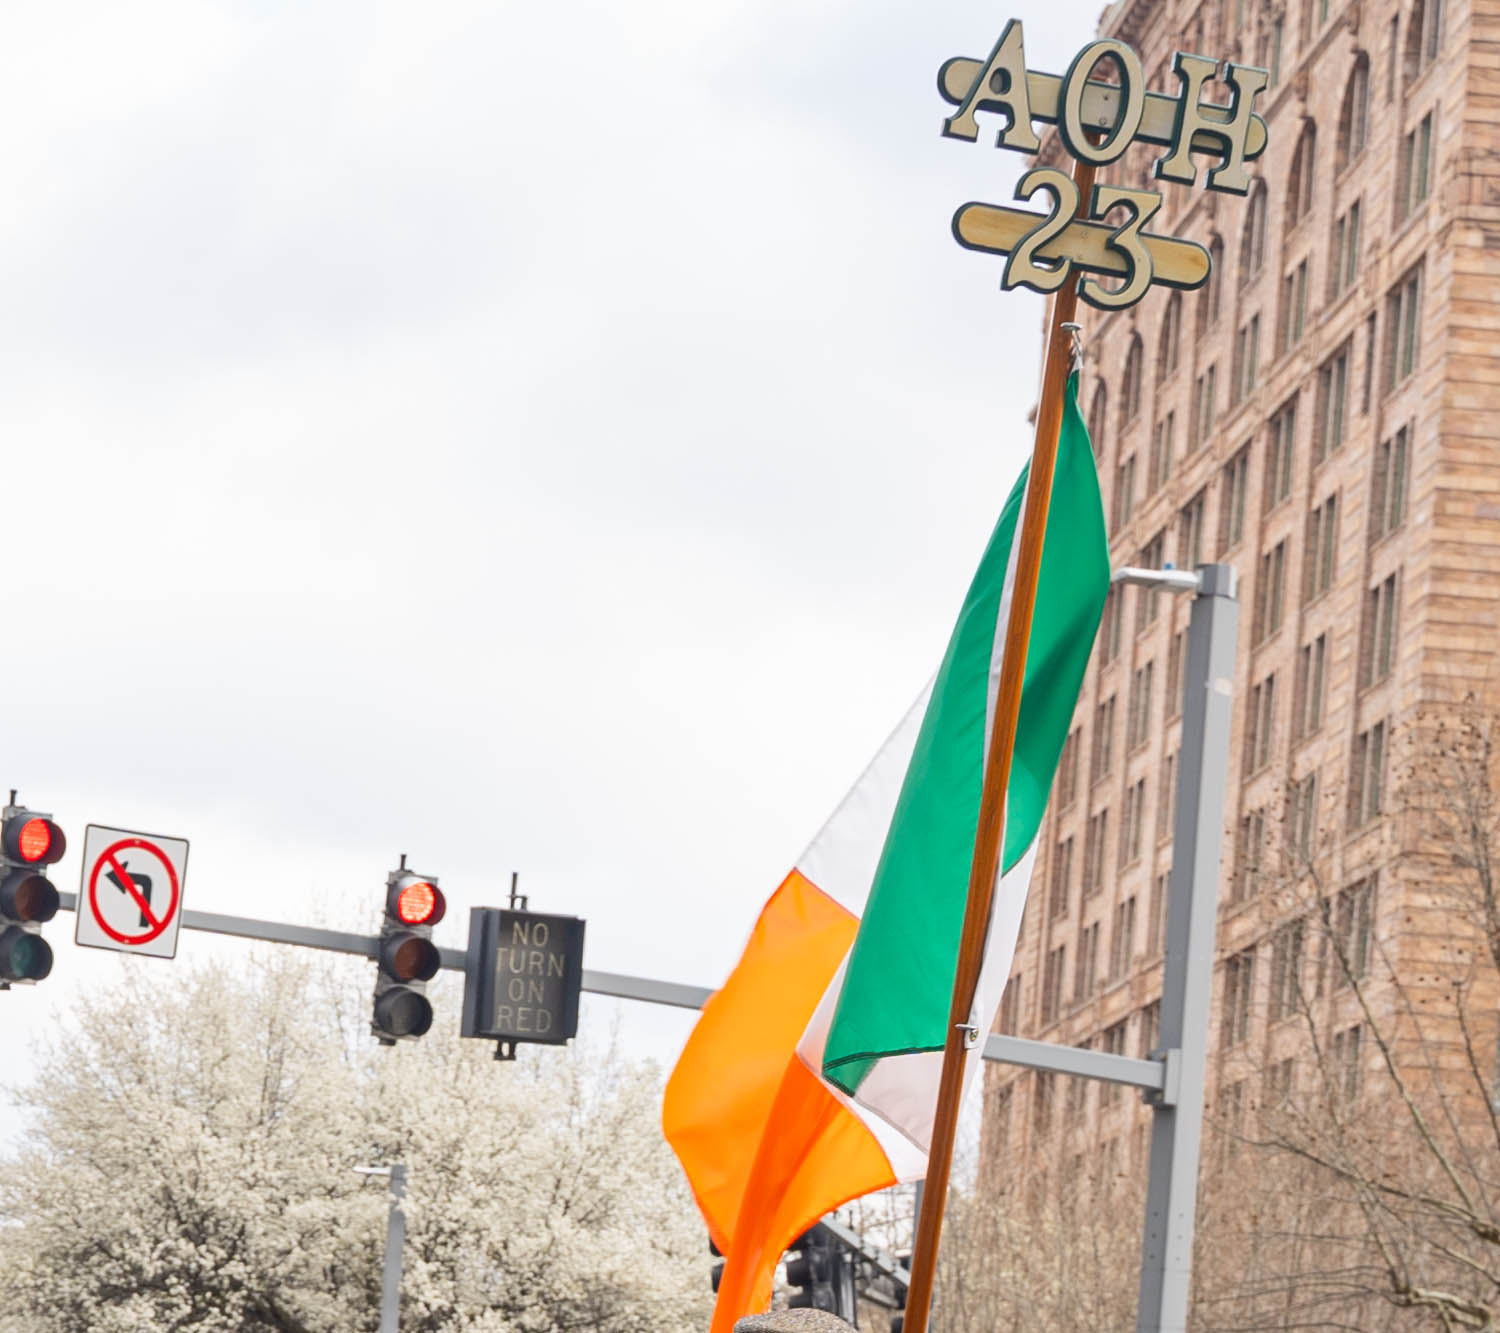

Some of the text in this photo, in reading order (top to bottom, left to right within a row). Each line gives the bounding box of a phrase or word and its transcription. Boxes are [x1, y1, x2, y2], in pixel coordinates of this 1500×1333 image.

[941, 18, 1269, 196] AOH
[999, 167, 1162, 311] 23
[512, 920, 550, 947] NO
[495, 947, 565, 977] TURN
[508, 978, 545, 1004] ON
[497, 1006, 552, 1033] RED
